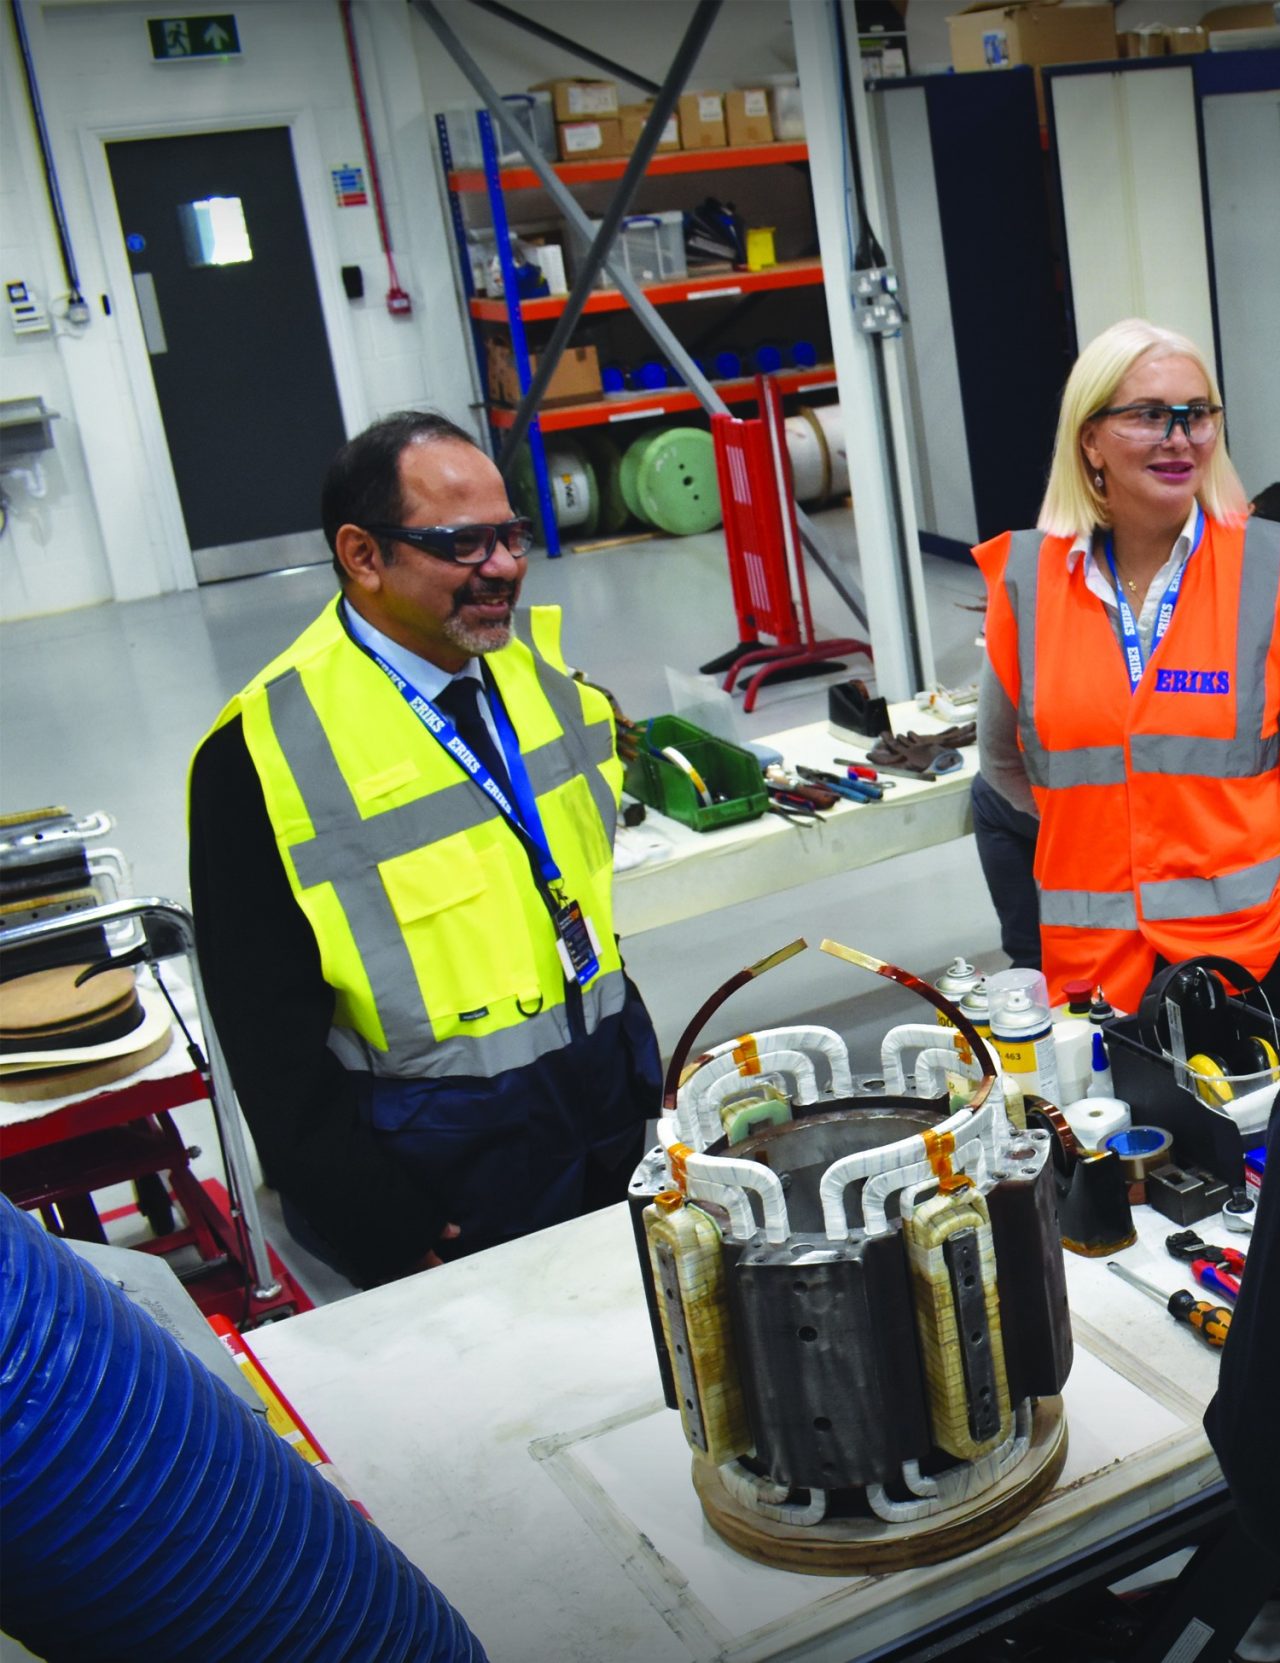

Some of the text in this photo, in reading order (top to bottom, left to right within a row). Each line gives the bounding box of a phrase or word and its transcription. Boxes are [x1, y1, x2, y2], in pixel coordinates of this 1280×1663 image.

[1120, 602, 1136, 636] ERIKS
[1156, 603, 1174, 637] ERIKS
[1127, 646, 1143, 682] ERIKS
[1155, 669, 1230, 694] ERIKS
[408, 696, 446, 733] ERIKS
[447, 736, 481, 774] ERIKS
[483, 778, 512, 814] ERIKS
[1004, 1052, 1022, 1061] 463
